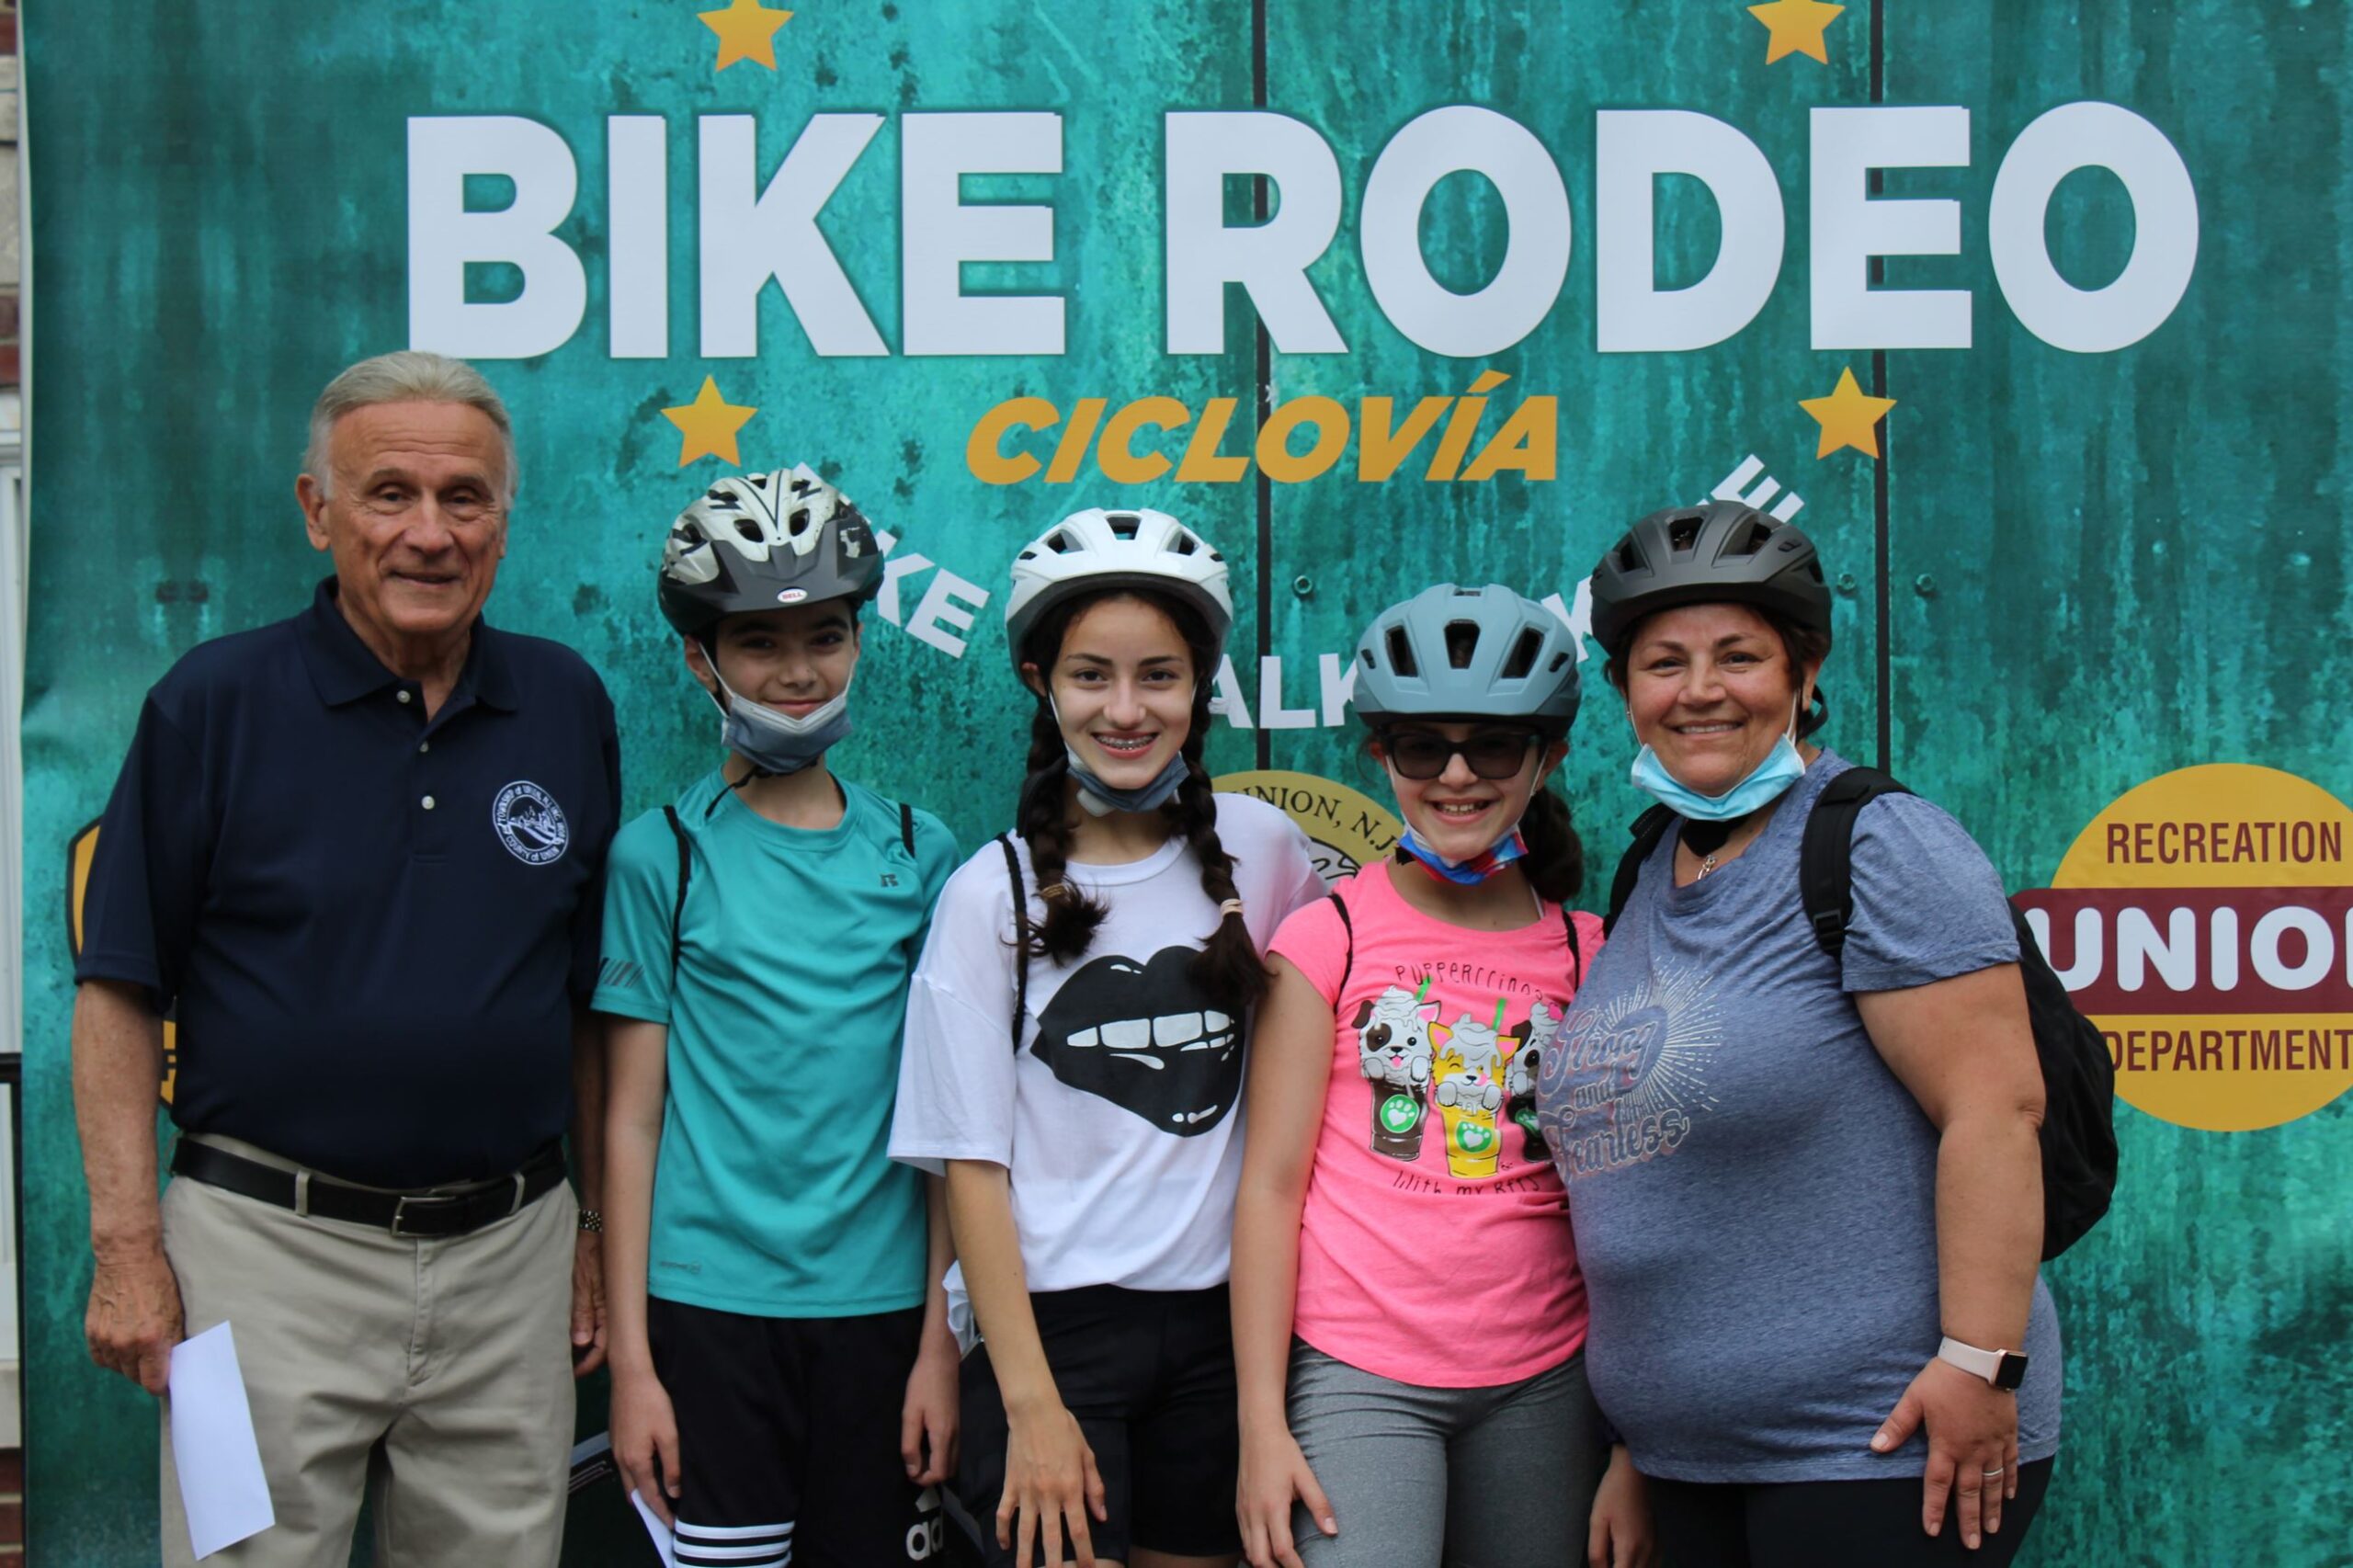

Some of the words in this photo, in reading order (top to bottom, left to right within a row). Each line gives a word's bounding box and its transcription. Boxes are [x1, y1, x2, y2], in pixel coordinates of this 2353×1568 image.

[406, 111, 1066, 359] BIKE
[1165, 101, 2199, 358] RODEO
[966, 370, 1558, 485] CICLOVÍA
[1208, 653, 1358, 729] ALK
[1237, 785, 1341, 829] NION,
[2107, 821, 2342, 864] RECREATION
[2024, 905, 2353, 993] UNIO
[1574, 1062, 1616, 1110] and
